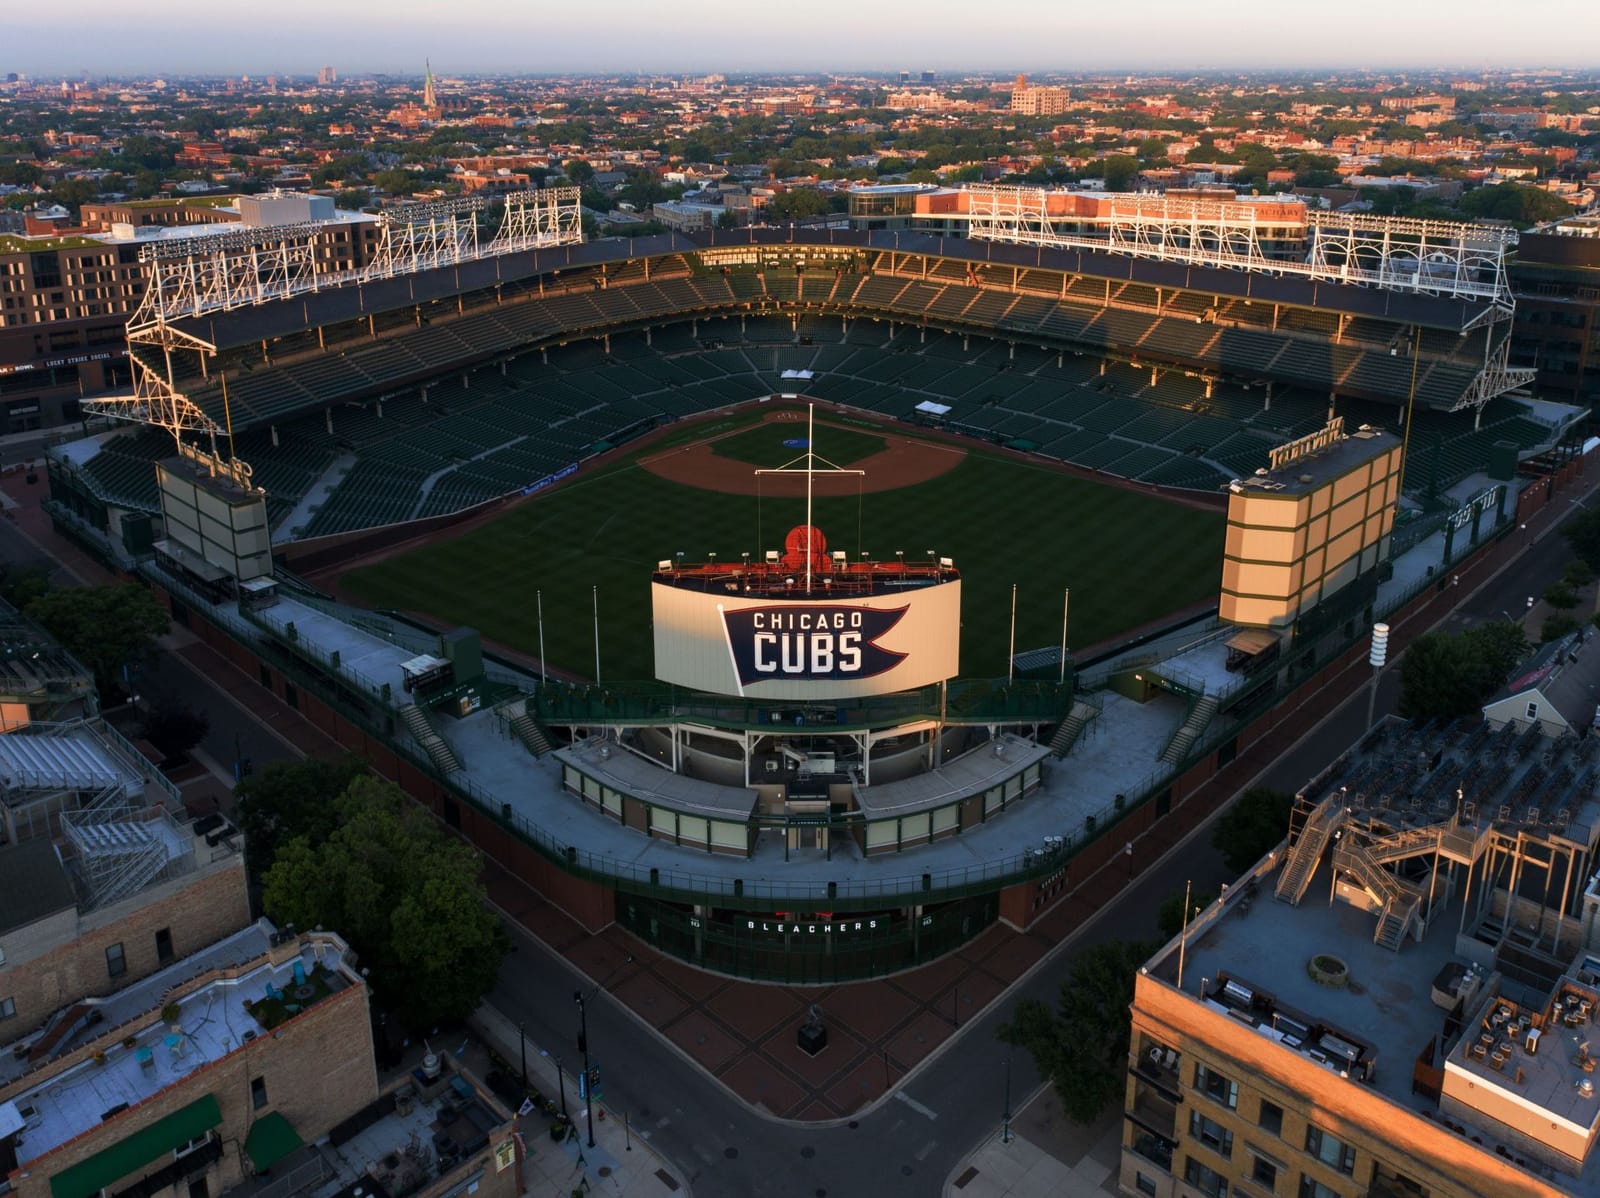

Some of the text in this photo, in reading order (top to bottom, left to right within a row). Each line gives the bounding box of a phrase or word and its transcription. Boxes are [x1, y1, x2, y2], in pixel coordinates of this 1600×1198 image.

[1256, 207, 1298, 216] ACHARY
[67, 356, 88, 364] STRIKE
[90, 353, 110, 361] SOCIAL
[753, 611, 862, 630] CHICAGO
[754, 630, 862, 673] CUBS
[747, 920, 877, 933] BLEACHERS
